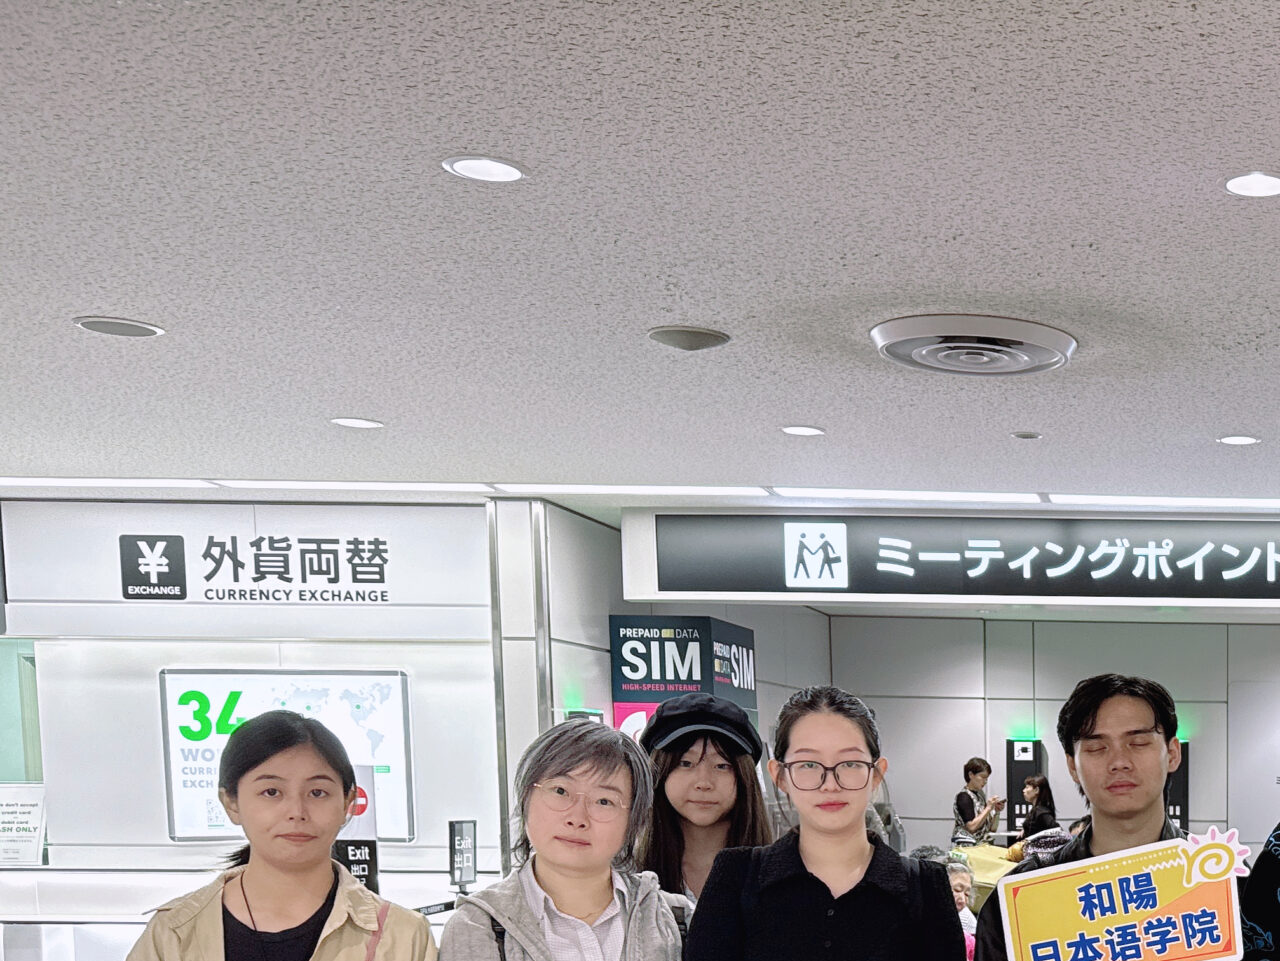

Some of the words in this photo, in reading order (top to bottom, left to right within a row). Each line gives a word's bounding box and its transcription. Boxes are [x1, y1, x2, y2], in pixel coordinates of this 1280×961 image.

[202, 535, 389, 584] 外貨両替
[127, 585, 181, 595] EXCHANGE
[204, 588, 292, 601] CURRENCY
[299, 589, 389, 602] EXCHANGE
[619, 628, 660, 638] PREPAID
[675, 628, 700, 639] DATA
[621, 640, 702, 681] SIM
[730, 644, 755, 691] SIM
[622, 683, 665, 692] HIGH-SPEED
[667, 684, 702, 692] INTERNET
[180, 748, 219, 762] WO
[183, 779, 214, 789] EXCH
[455, 836, 472, 849] Exit
[347, 846, 370, 860] Exit
[455, 853, 473, 868] 出口
[350, 864, 369, 876] 出口
[1077, 872, 1159, 921] 和陽
